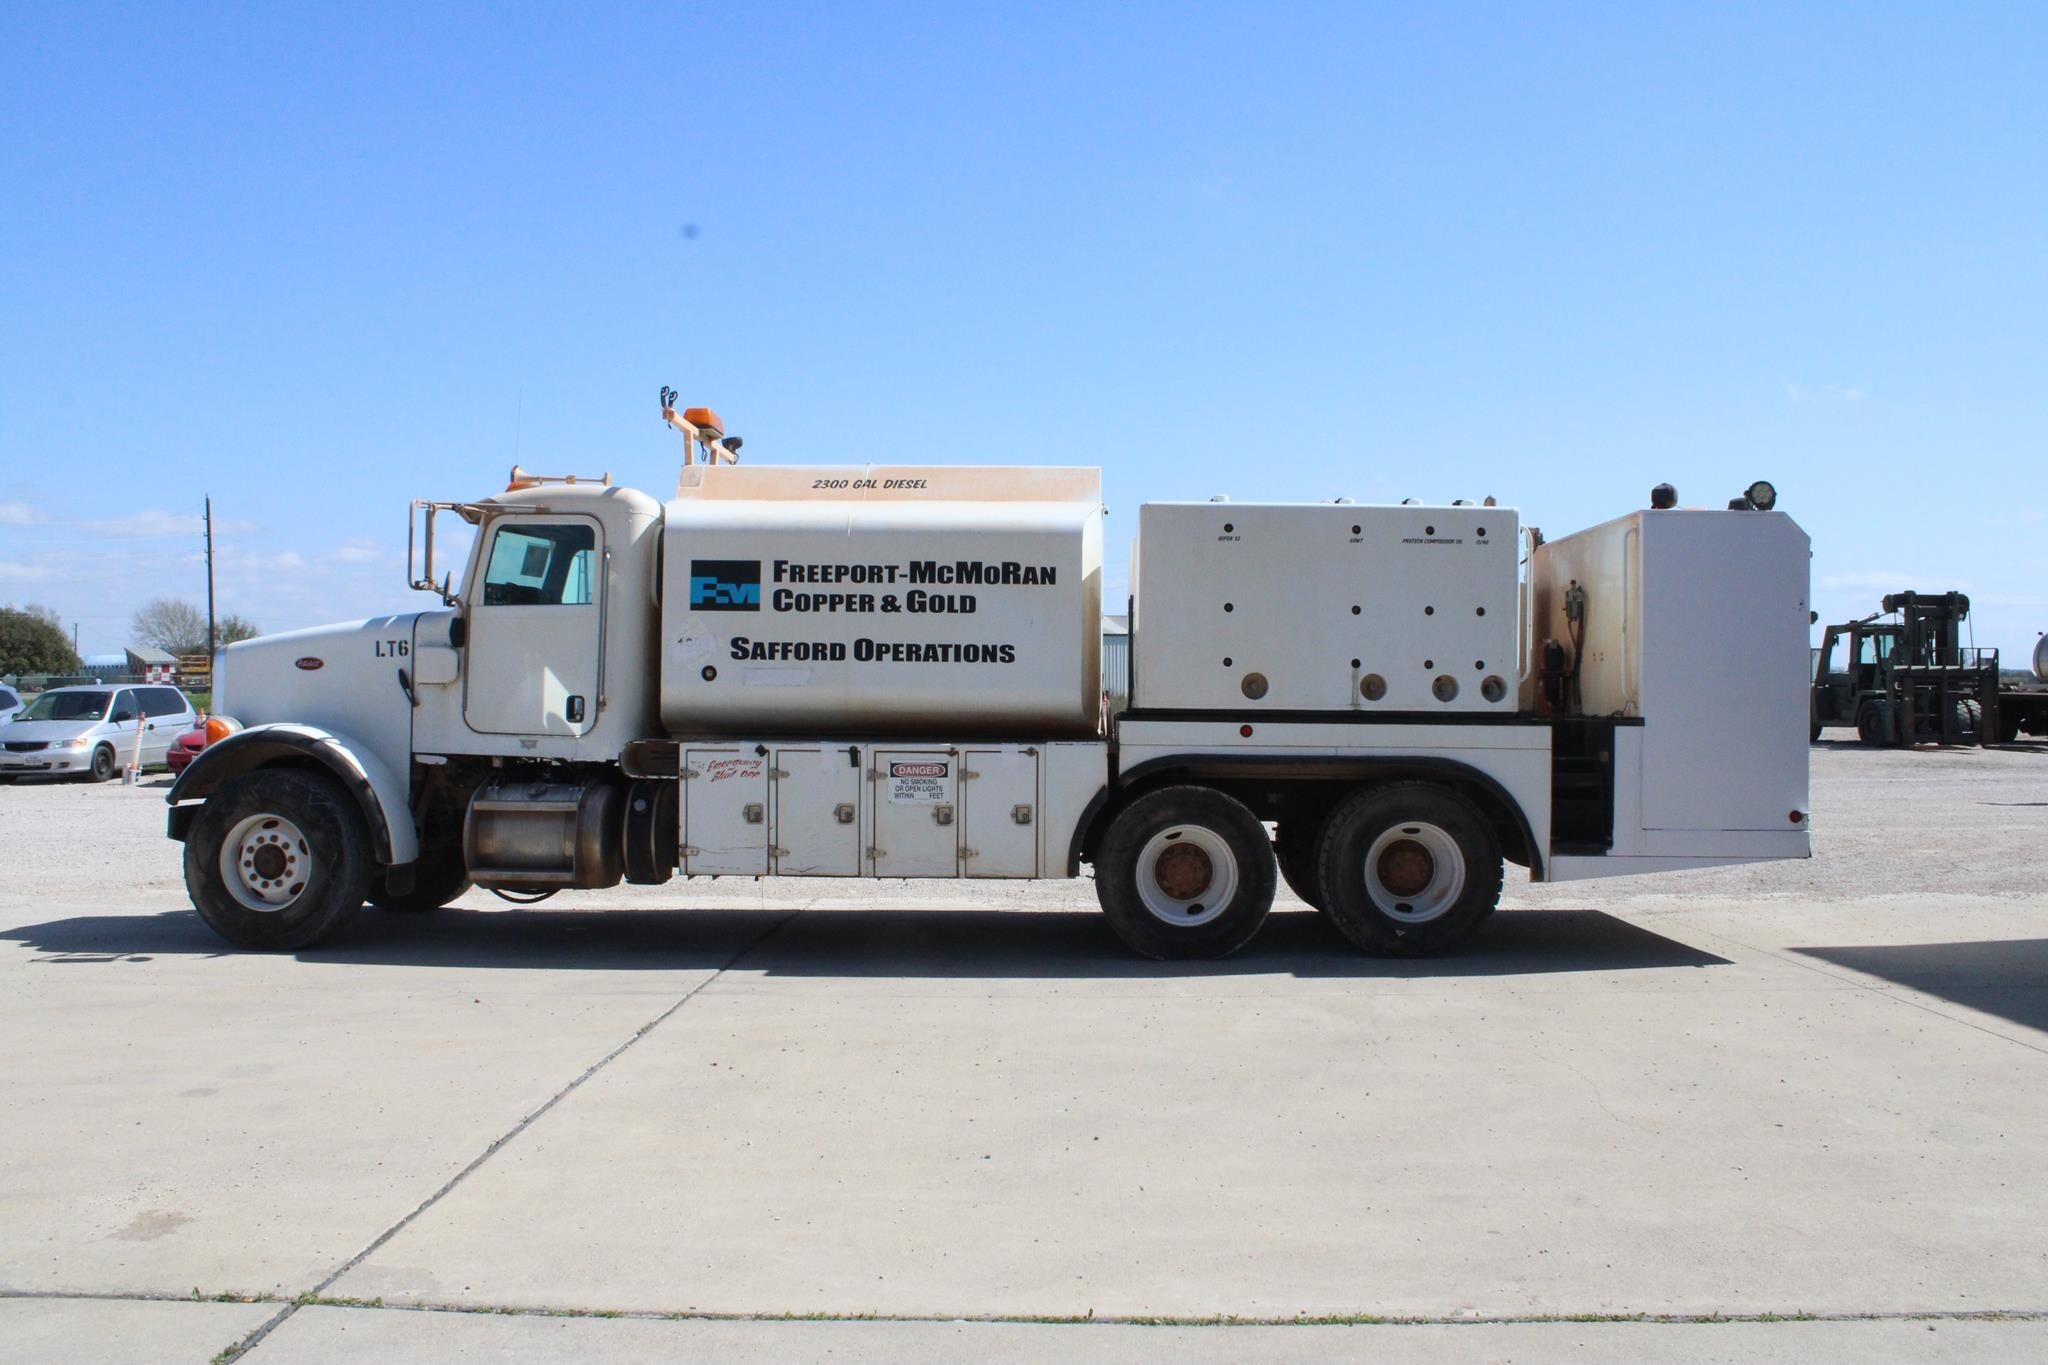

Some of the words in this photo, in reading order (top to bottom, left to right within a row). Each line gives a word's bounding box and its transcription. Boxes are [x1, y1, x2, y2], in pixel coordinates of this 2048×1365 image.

[812, 479, 849, 489] 2300
[852, 479, 878, 489] GAL
[883, 479, 927, 489] DIESEL
[773, 588, 875, 613] COPPER
[880, 594, 902, 614] &
[906, 590, 976, 613] GOLD
[376, 639, 409, 657] LT6
[731, 636, 846, 661] SAFFORD
[854, 638, 1015, 663] OPERATIONS
[898, 766, 940, 775] DANGER
